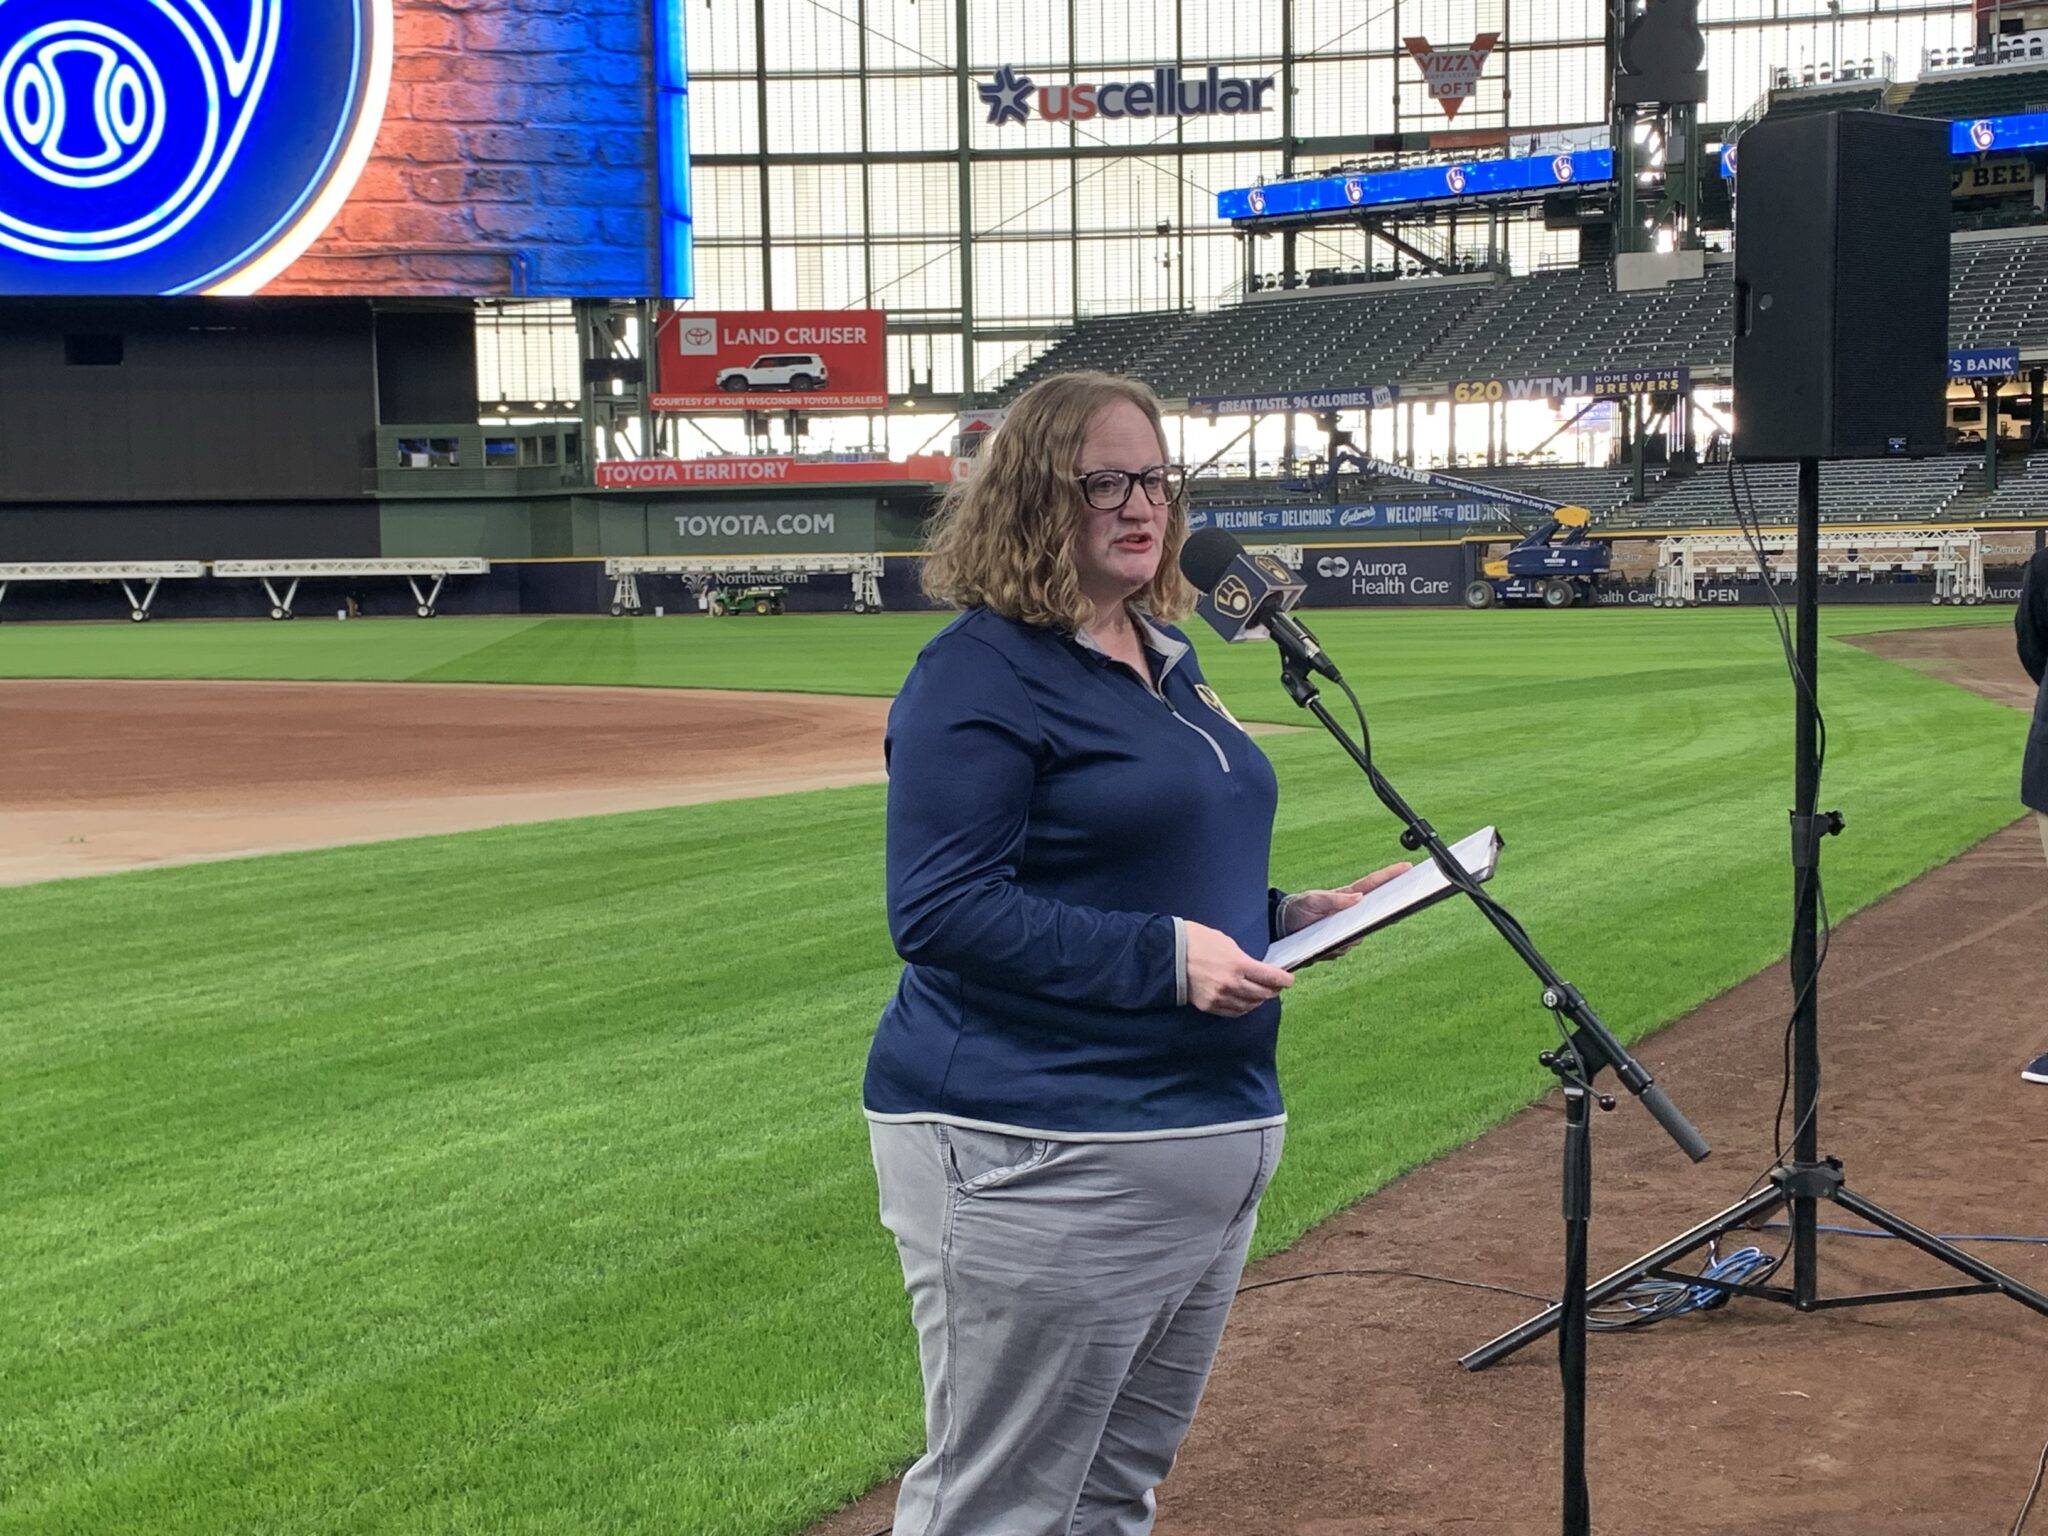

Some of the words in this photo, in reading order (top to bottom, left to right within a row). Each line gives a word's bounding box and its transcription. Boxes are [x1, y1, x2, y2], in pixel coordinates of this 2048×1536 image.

[1418, 54, 1486, 73] VIZZY
[1038, 65, 1274, 122] uscellular
[1431, 82, 1474, 96] LOFT
[723, 328, 780, 346] LAND
[784, 327, 867, 345] CRUISER
[1966, 356, 2012, 372] BANK
[1595, 374, 1628, 383] HOME
[1634, 372, 1650, 381] OF
[1656, 371, 1679, 379] THE
[1454, 380, 1503, 402] 620
[1507, 376, 1588, 398] WTMJ
[1595, 379, 1679, 394] BREWERS
[652, 397, 702, 407] COURTESY
[703, 397, 715, 407] OF
[718, 397, 745, 407] YOUR
[747, 396, 801, 406] WISCONSIN
[803, 396, 841, 406] TOYOTA
[842, 395, 884, 405] DEALERS
[1218, 400, 1253, 413] GREAT
[1254, 398, 1291, 412] TASTE.
[1293, 396, 1309, 409] 96
[1311, 393, 1370, 408] CALORIES.
[602, 464, 677, 482] TOYOTA
[682, 461, 788, 481] TERRITORY
[1377, 461, 1431, 485] WOLTER
[1215, 511, 1264, 528] WELCOME
[1282, 509, 1333, 527] DELICIOUS
[1386, 505, 1438, 523] WELCOME
[674, 513, 835, 536] TOYOTA.COM
[1352, 560, 1407, 576] Aurora
[715, 572, 808, 584] Northwestern
[1352, 577, 1405, 595] Health
[1410, 577, 1449, 595] Care
[1597, 589, 1624, 603] ealth
[1628, 590, 1657, 603] Care
[1699, 589, 1739, 602] LPEN
[1985, 586, 2023, 599] Auror
